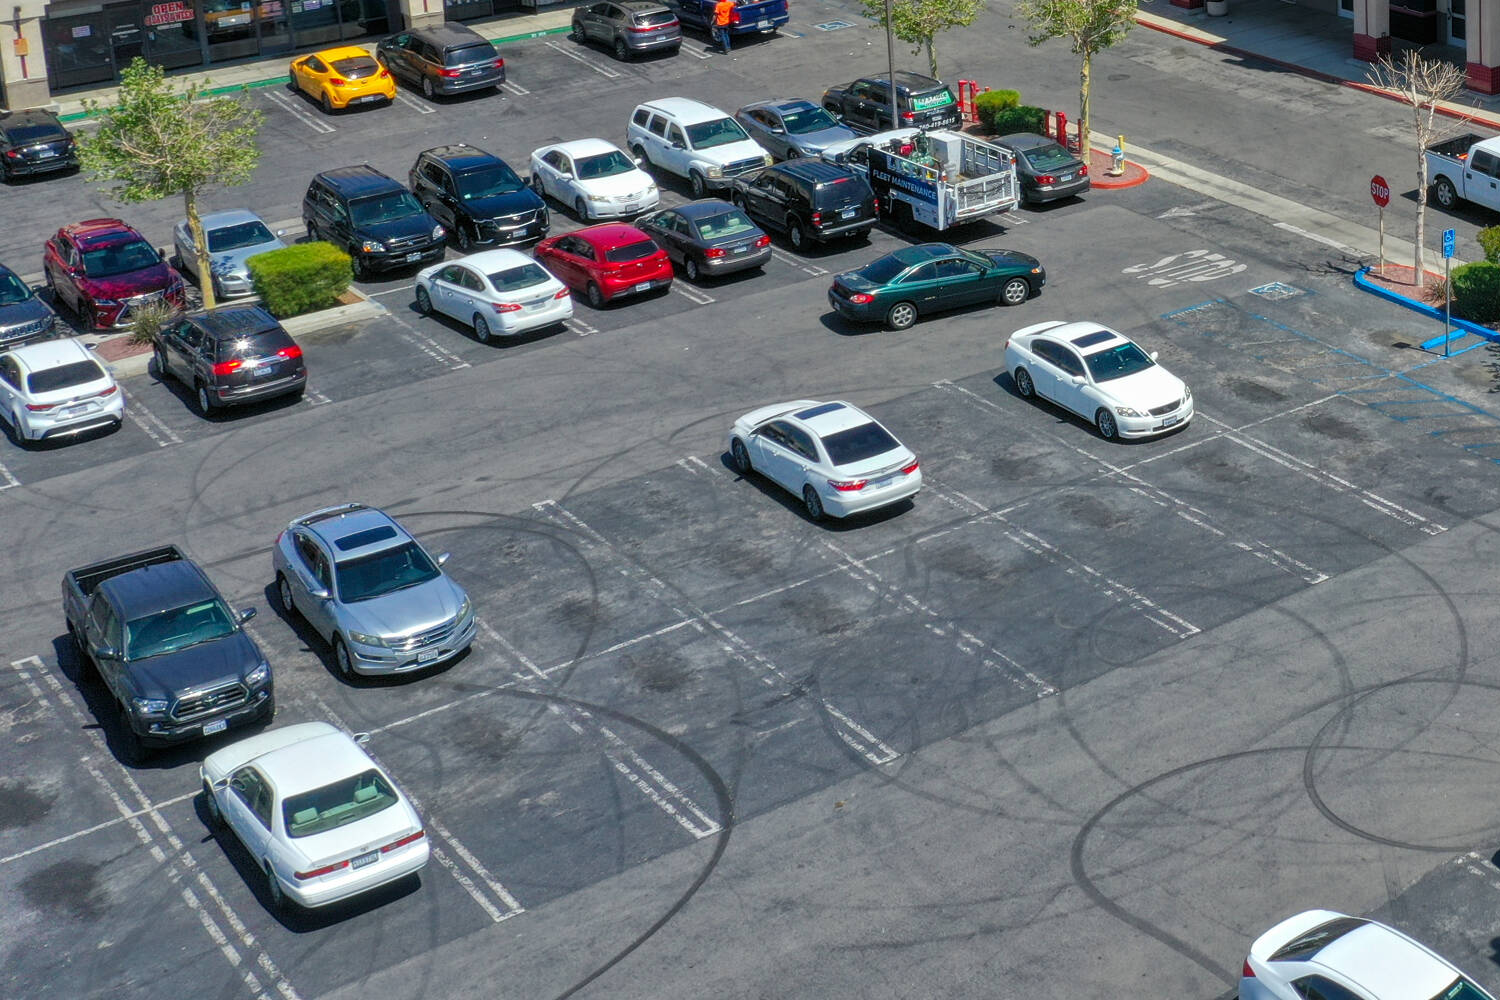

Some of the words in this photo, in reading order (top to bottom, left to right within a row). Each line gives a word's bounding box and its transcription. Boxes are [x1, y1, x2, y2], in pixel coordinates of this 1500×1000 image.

[152, 1, 184, 15] OPEN
[873, 169, 890, 182] FLEET
[892, 176, 937, 200] MAINTENANCE
[1371, 182, 1389, 199] STOP
[1121, 249, 1248, 289] STOP
